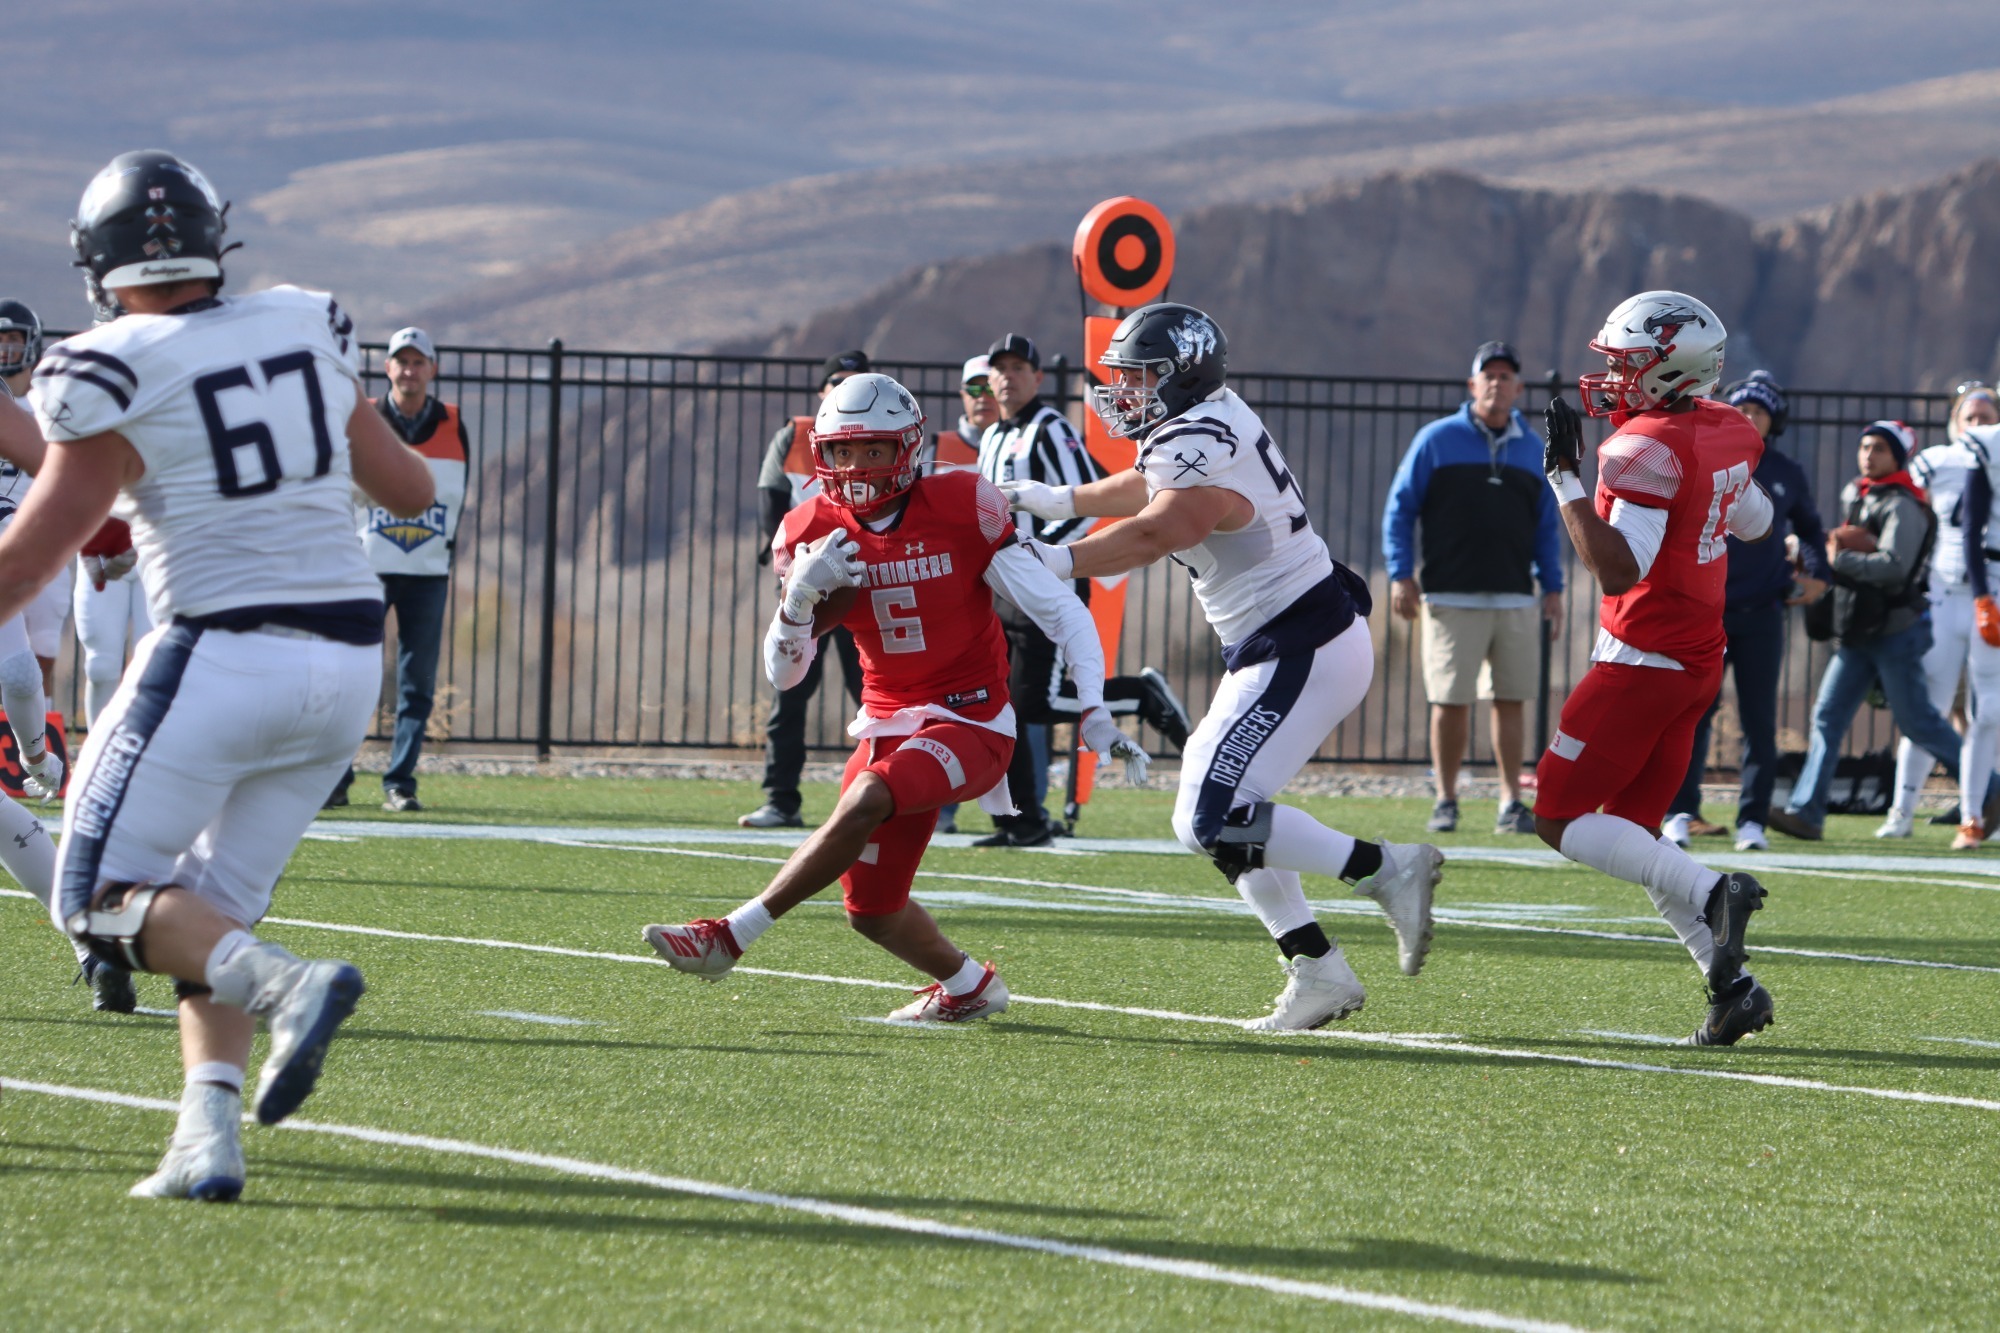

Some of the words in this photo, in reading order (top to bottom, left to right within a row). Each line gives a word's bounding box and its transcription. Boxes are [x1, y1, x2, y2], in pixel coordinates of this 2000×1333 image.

[148, 187, 165, 199] 67
[194, 350, 332, 498] 67
[858, 552, 952, 588] NTAINEERS
[871, 586, 926, 653] 6
[919, 740, 952, 765] 7723
[1208, 704, 1281, 787] OREDIGGERS
[74, 724, 144, 839] OREDIGGERS
